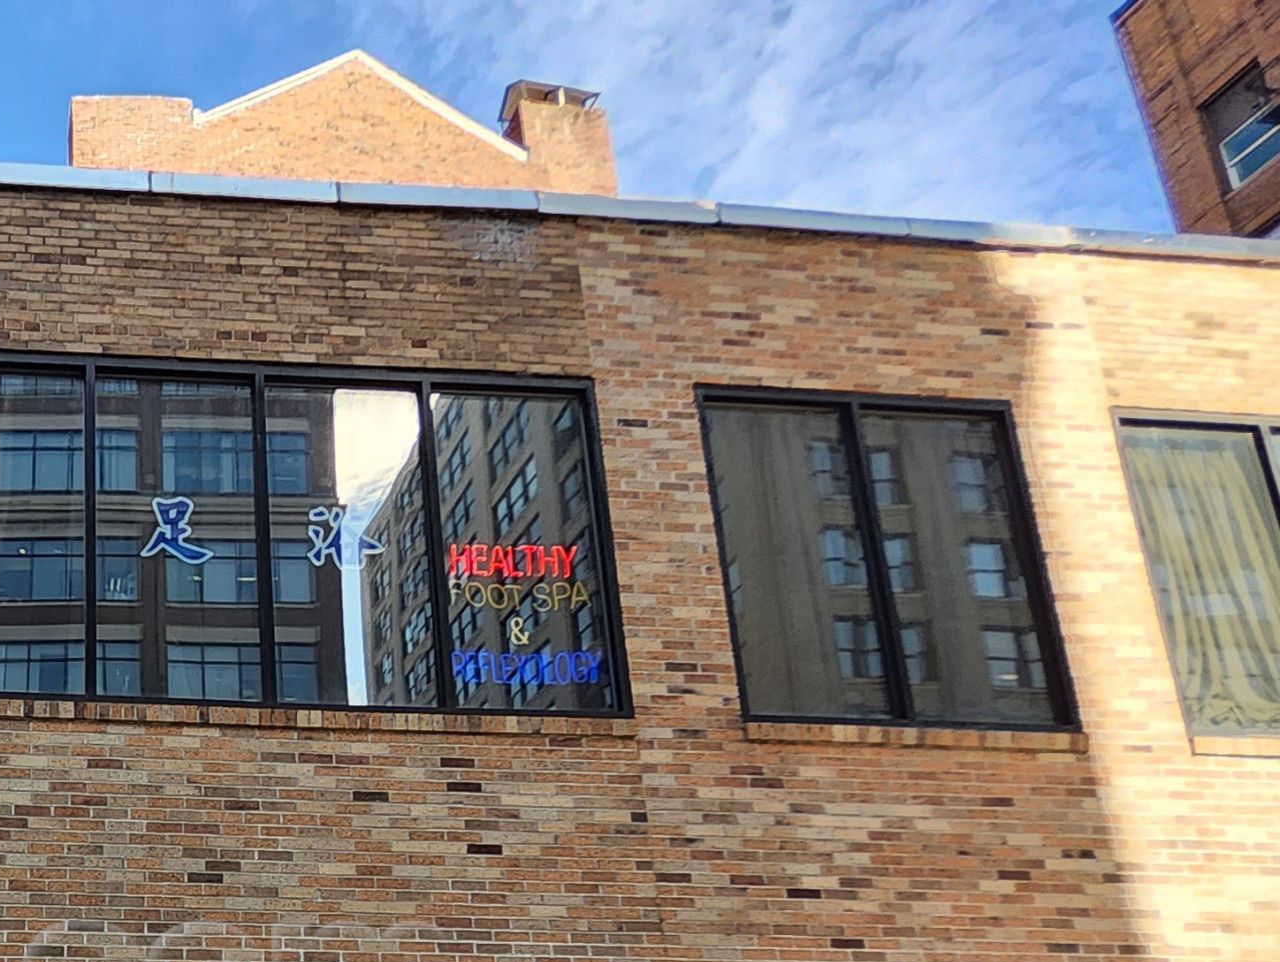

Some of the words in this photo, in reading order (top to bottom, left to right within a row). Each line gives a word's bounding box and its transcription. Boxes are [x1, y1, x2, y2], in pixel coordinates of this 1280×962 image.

[140, 497, 214, 564] 足
[449, 543, 578, 578] HEALTHY
[449, 579, 522, 610] FOOT
[532, 581, 592, 612] SPA
[510, 617, 529, 645] &
[451, 650, 602, 686] REFLEXOLOGY
